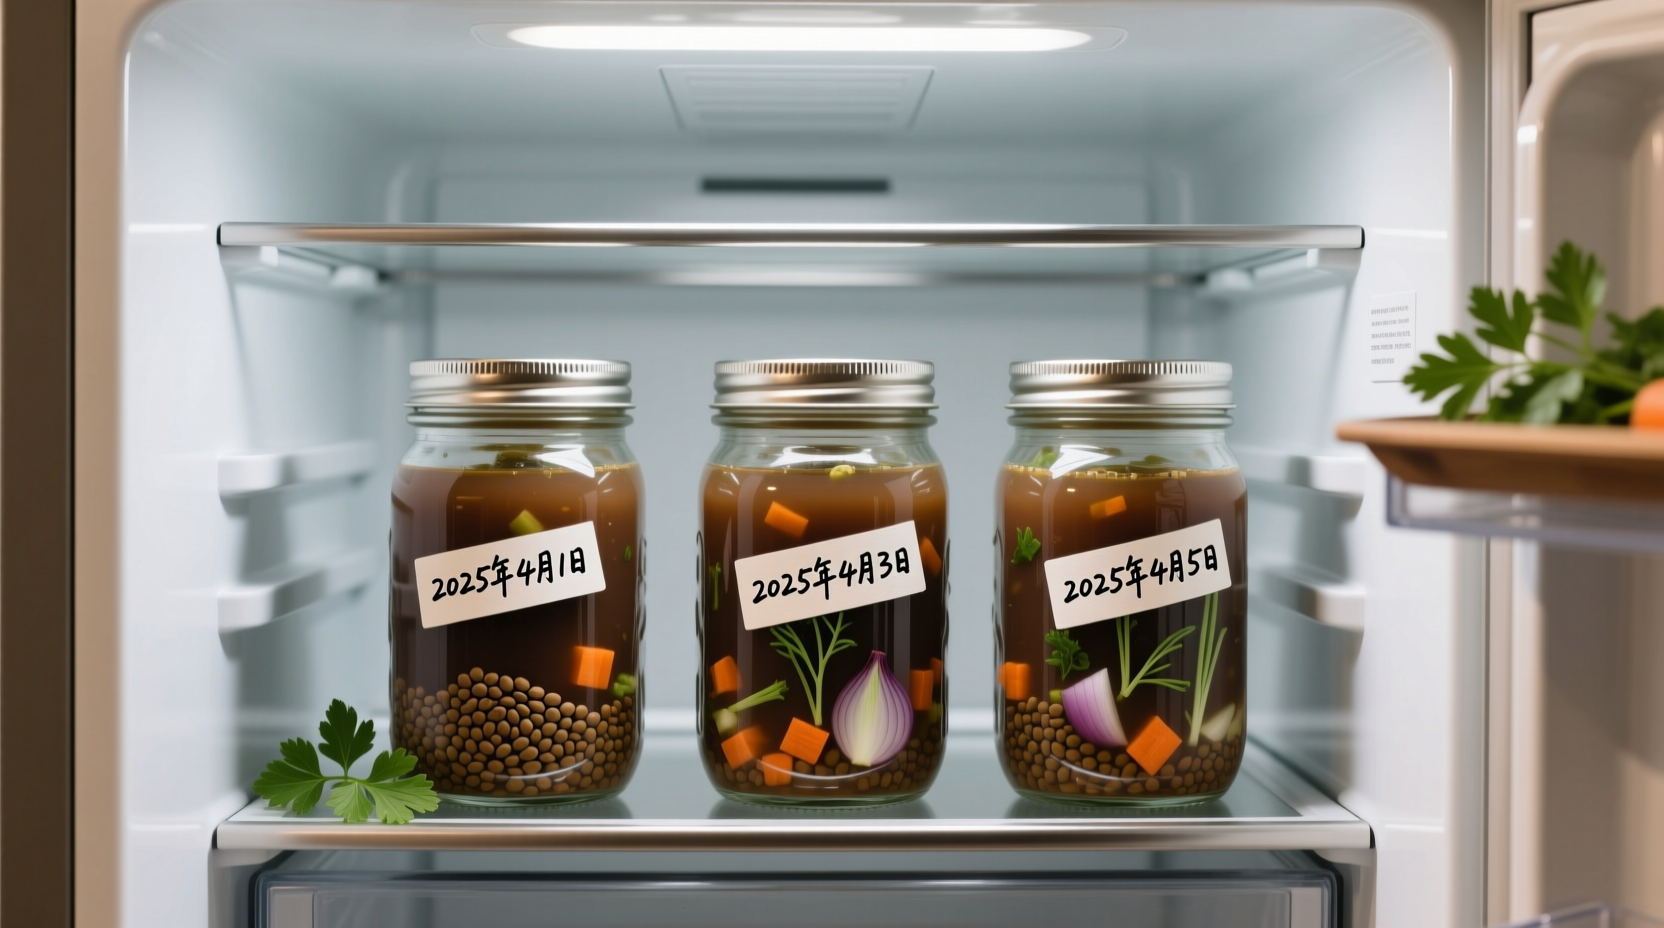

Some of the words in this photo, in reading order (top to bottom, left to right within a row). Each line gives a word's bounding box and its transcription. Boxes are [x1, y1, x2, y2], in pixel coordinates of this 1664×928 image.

[431, 546, 586, 602] 2025年4月1日
[752, 547, 910, 605] 2025年4月3日
[1063, 544, 1218, 604] 2025年4月5日
